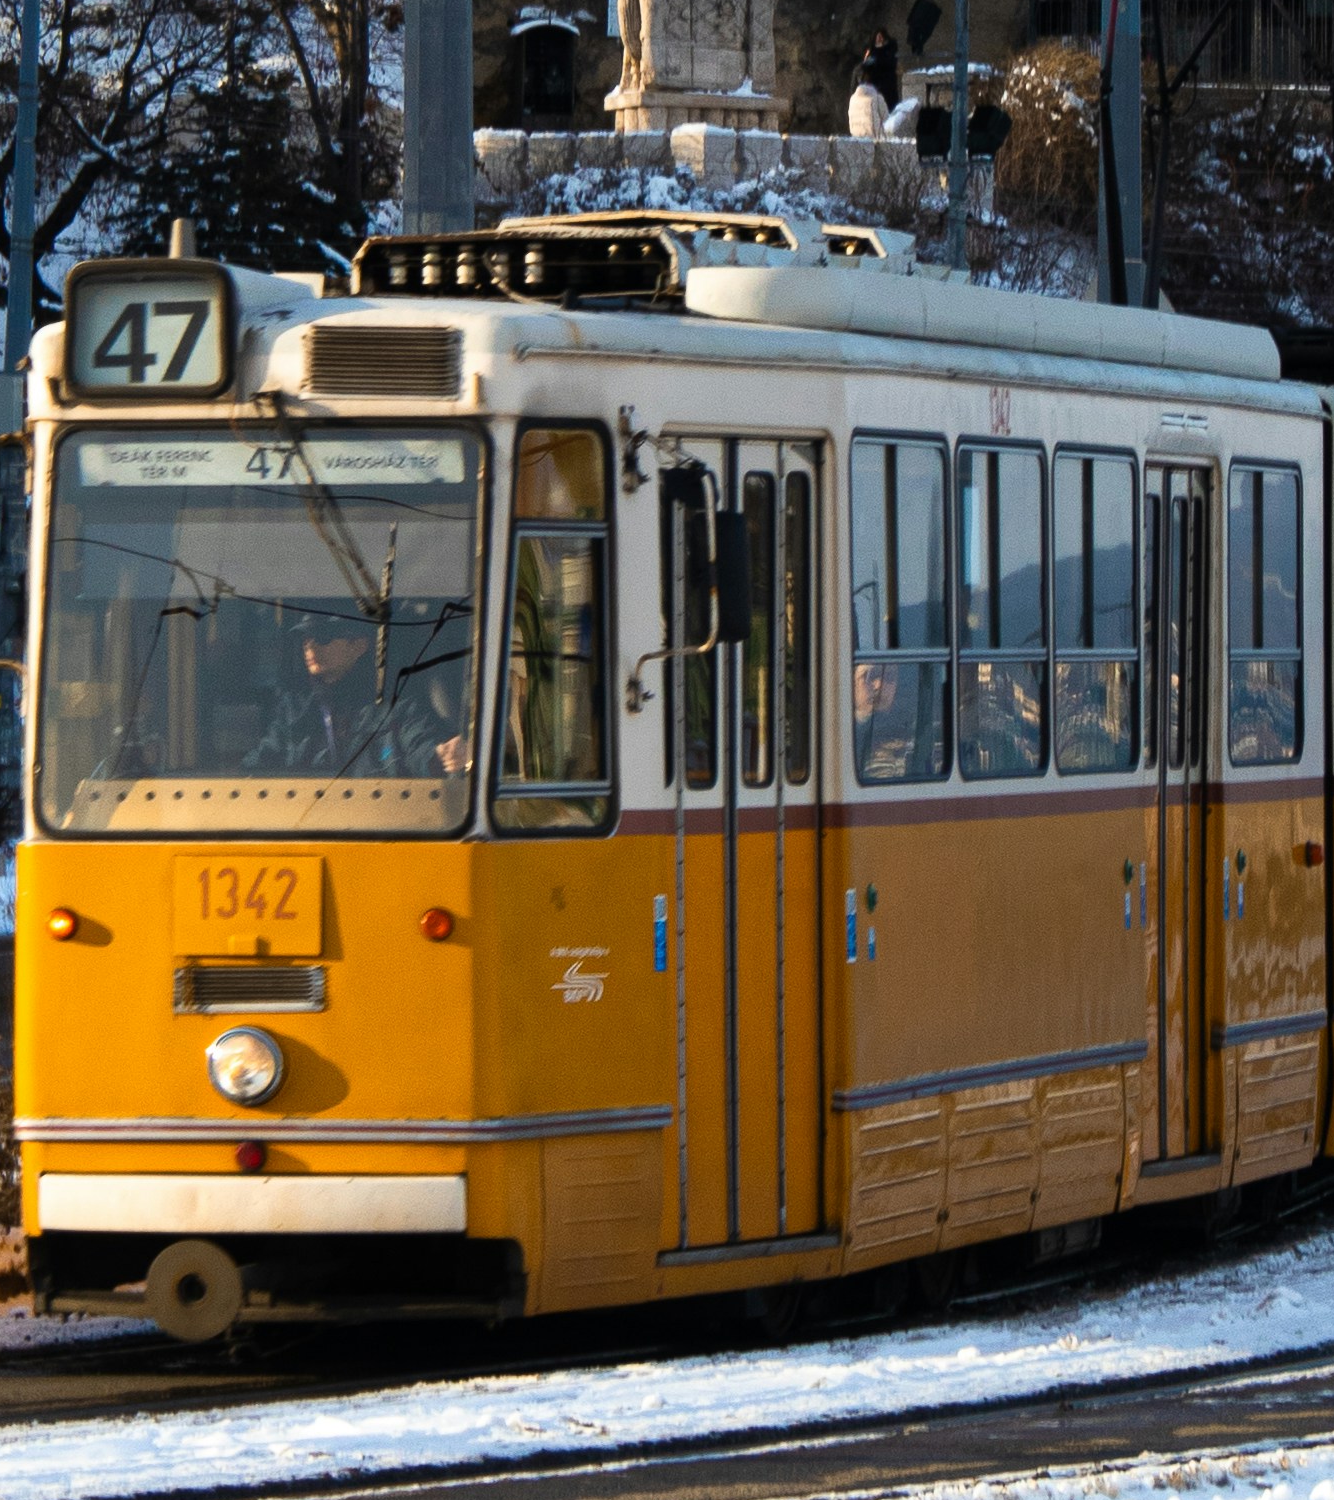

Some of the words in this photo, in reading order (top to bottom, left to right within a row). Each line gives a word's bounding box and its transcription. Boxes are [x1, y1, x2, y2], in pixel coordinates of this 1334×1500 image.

[94, 300, 211, 383] 47
[245, 446, 299, 480] 47
[197, 868, 299, 919] 1342
